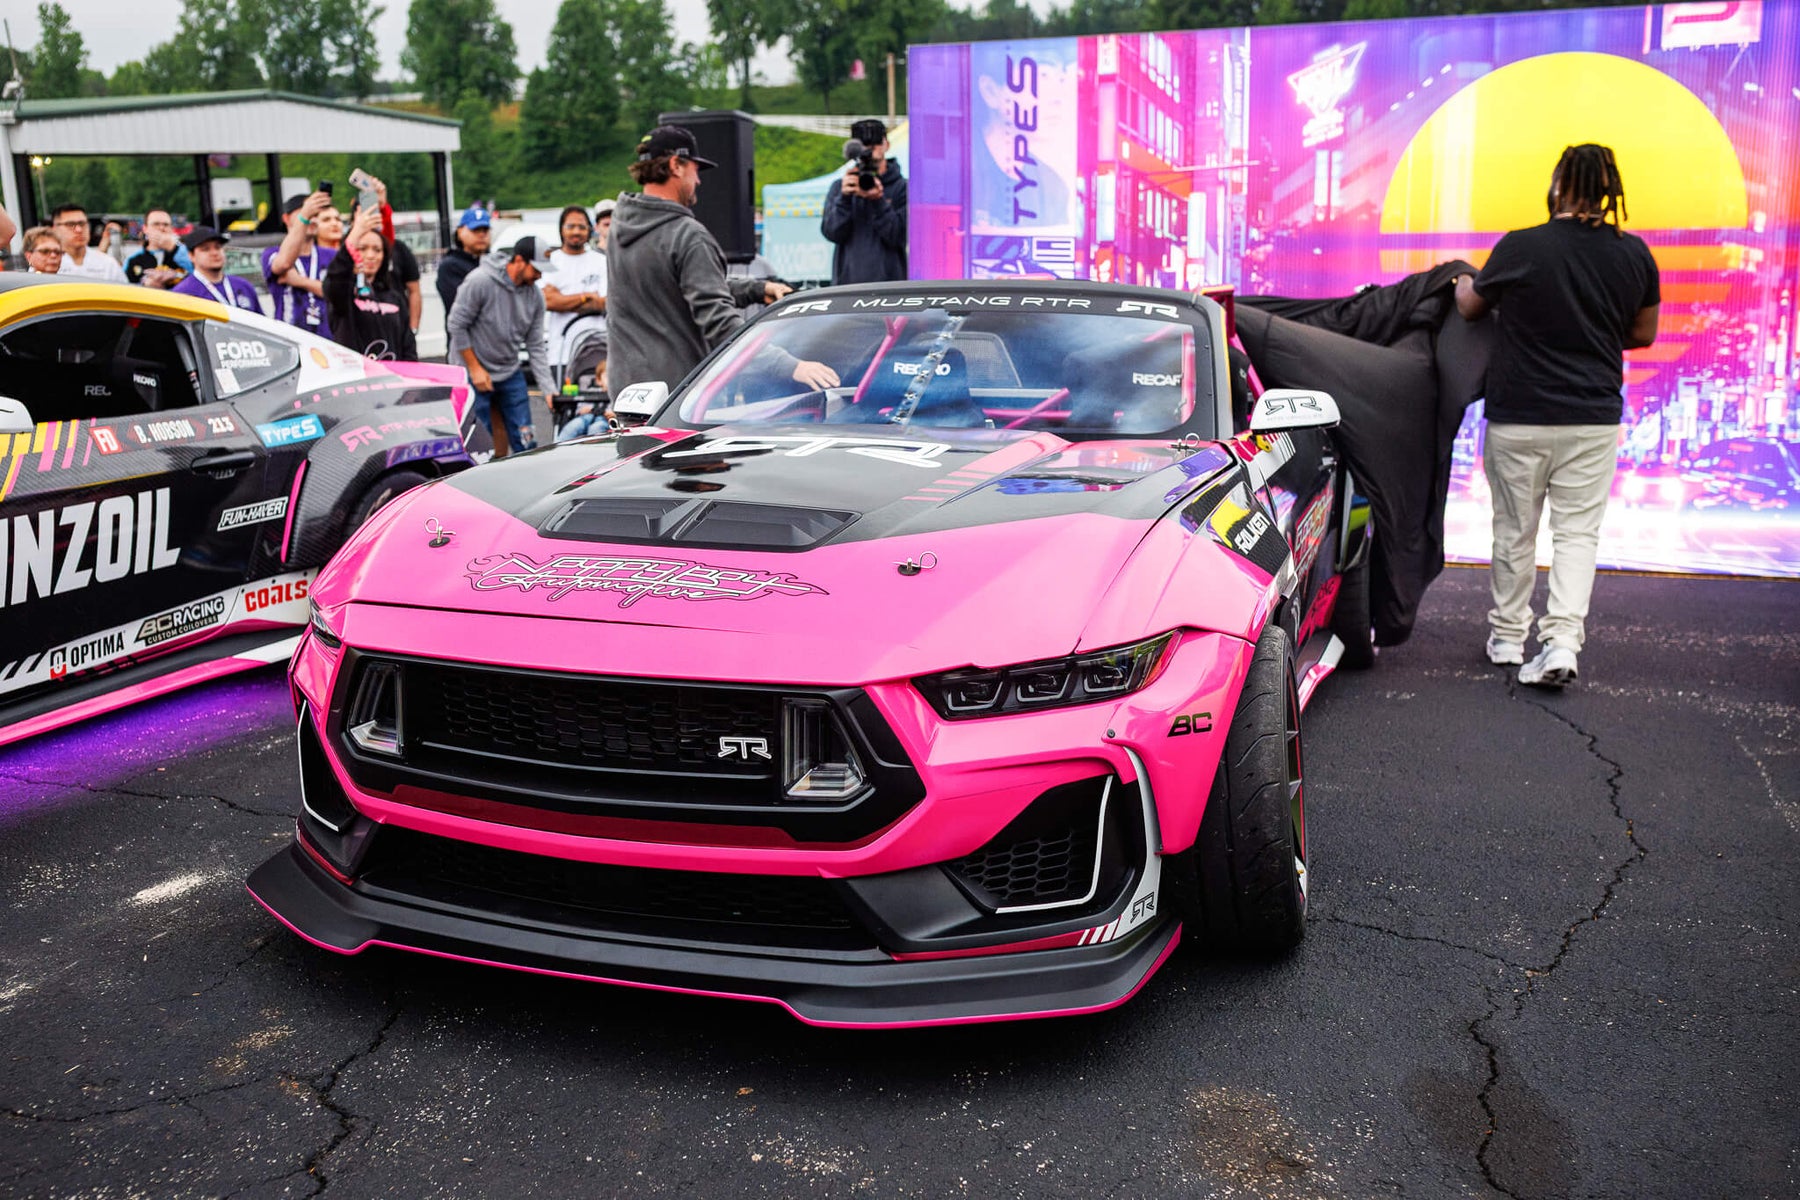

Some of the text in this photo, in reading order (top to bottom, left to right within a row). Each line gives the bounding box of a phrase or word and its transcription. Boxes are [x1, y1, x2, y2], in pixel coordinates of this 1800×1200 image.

[852, 296, 1091, 309] MUSTANG RTR
[215, 341, 267, 361] FORD
[148, 418, 196, 442] HOBSON
[207, 416, 235, 434] 213
[0, 487, 181, 608] NZOIL
[147, 629, 178, 645] CUSTOM
[71, 631, 125, 667] OPTIMA
[1166, 711, 1213, 738] BC
